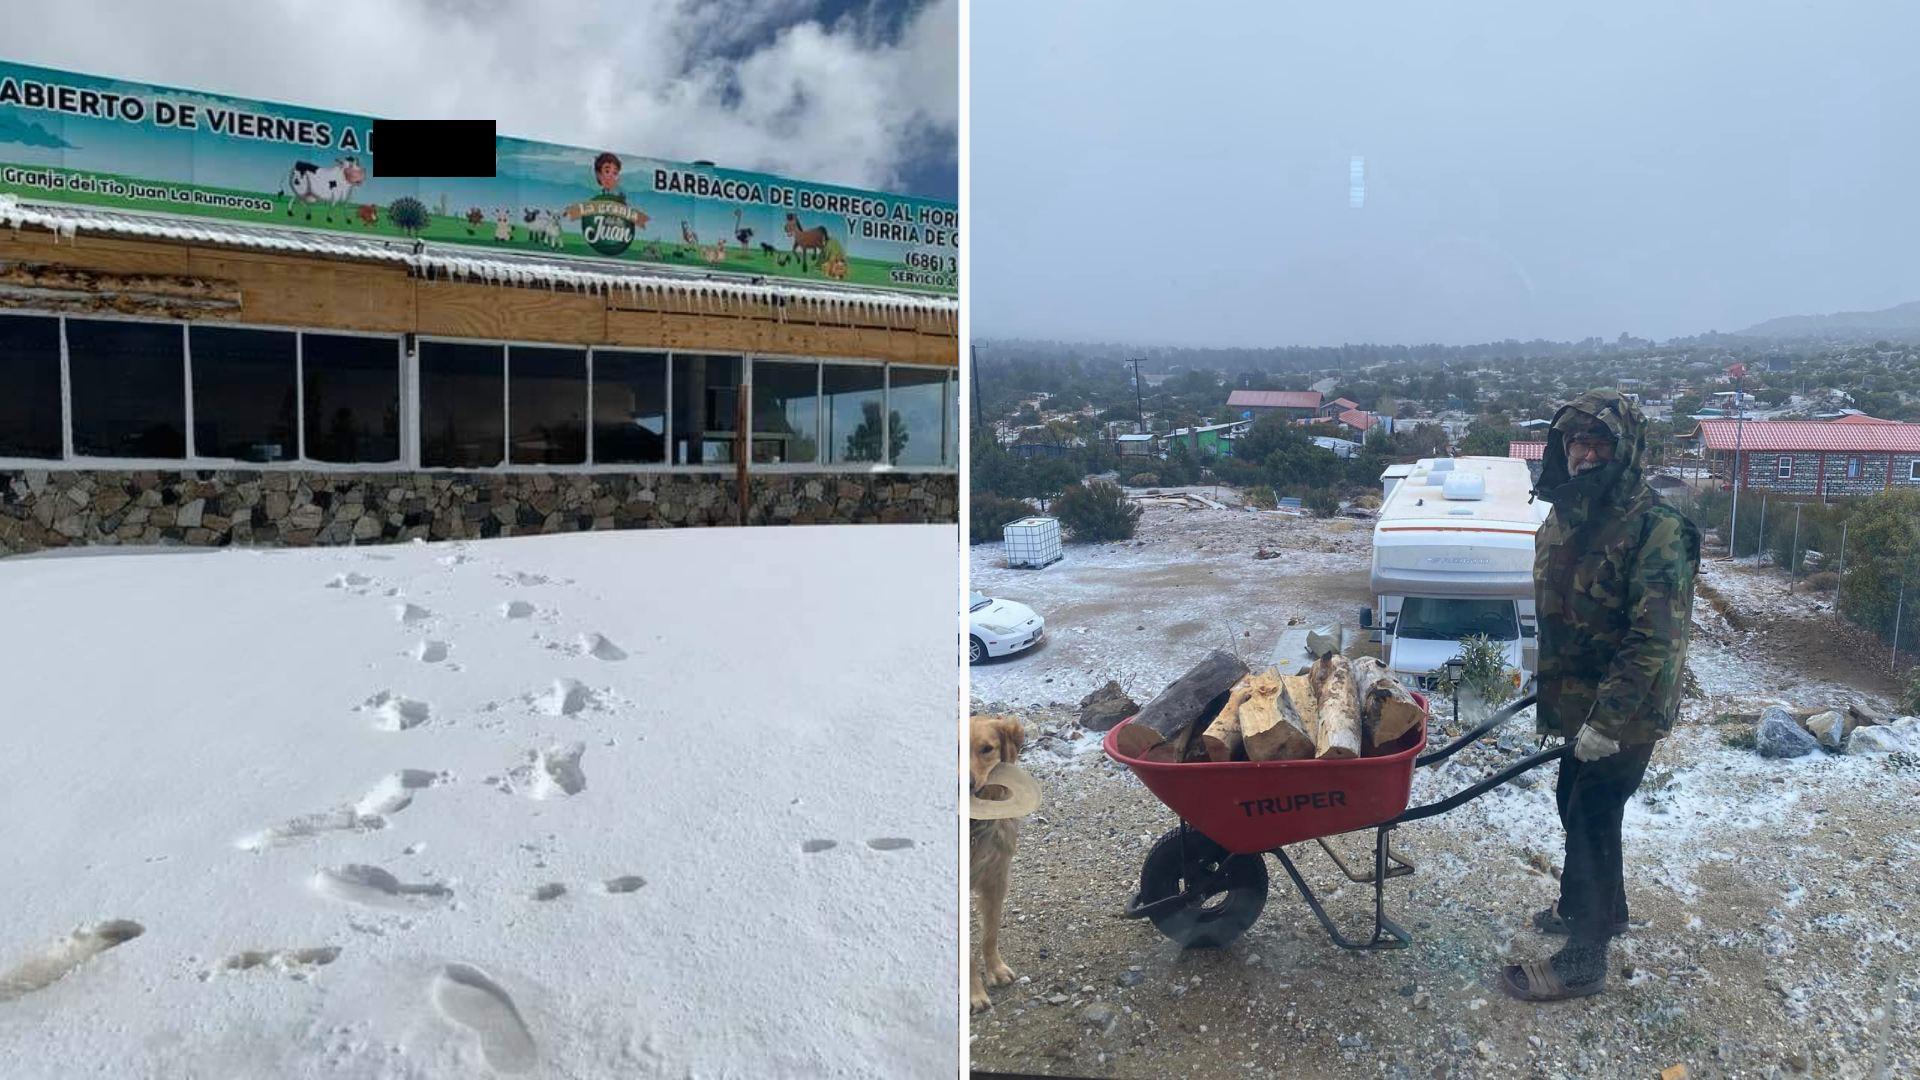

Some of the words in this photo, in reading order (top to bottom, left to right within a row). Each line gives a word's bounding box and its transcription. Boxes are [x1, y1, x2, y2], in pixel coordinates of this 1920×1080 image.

[0, 79, 145, 121] ABIERTO
[155, 101, 196, 128] DE
[206, 107, 331, 146] VIERNES
[340, 128, 359, 150] A
[5, 168, 64, 189] Granja
[69, 175, 96, 192] del
[128, 184, 167, 198] Juan
[171, 189, 190, 201] La
[194, 190, 272, 211] Rumorosa
[654, 169, 763, 203] BARBACOA
[769, 186, 794, 206] DE
[800, 191, 887, 218] BORREGO
[892, 203, 914, 222] AL
[918, 207, 958, 229] HOR
[584, 215, 633, 244] Juan
[847, 218, 856, 235] Y
[862, 220, 920, 243] BIRRIA
[925, 228, 946, 246] DE
[905, 251, 944, 272] (686)
[947, 256, 957, 273] 3
[890, 270, 945, 286] SERVICIO
[1238, 790, 1347, 818] TRUPER
